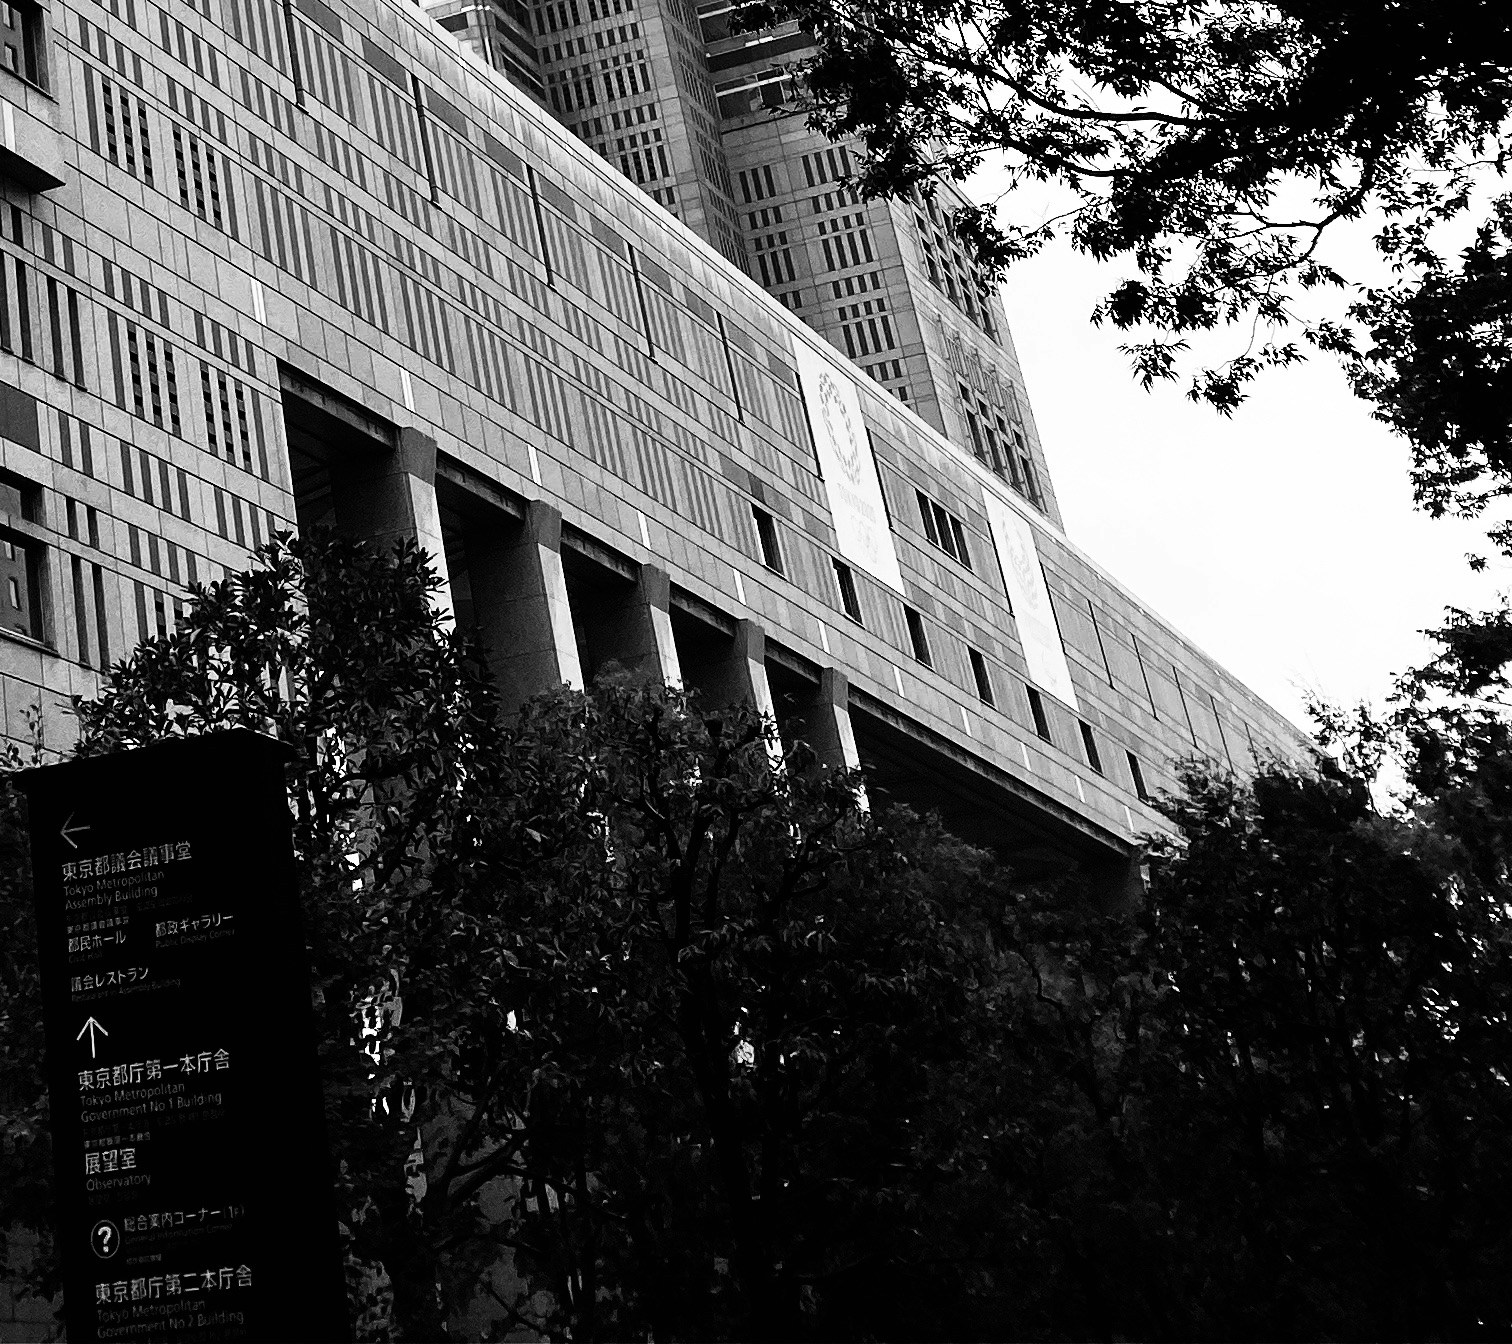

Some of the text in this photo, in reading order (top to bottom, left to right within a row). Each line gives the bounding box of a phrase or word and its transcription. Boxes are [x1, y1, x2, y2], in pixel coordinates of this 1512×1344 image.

[63, 870, 166, 898] Tokyo Metropolitan
[65, 893, 113, 911] Assembly
[115, 885, 159, 903] Building
[77, 1047, 231, 1092] 東京都庁第一本庁舎
[80, 1082, 186, 1108] Tokyo Metropolitan
[80, 1102, 147, 1124] Government
[177, 1091, 223, 1110] Building
[85, 1147, 138, 1176] 展望室
[86, 1172, 152, 1192] Observatory
[94, 1263, 253, 1306] 東京都庁第二本庁舎
[197, 1310, 245, 1327] Building
